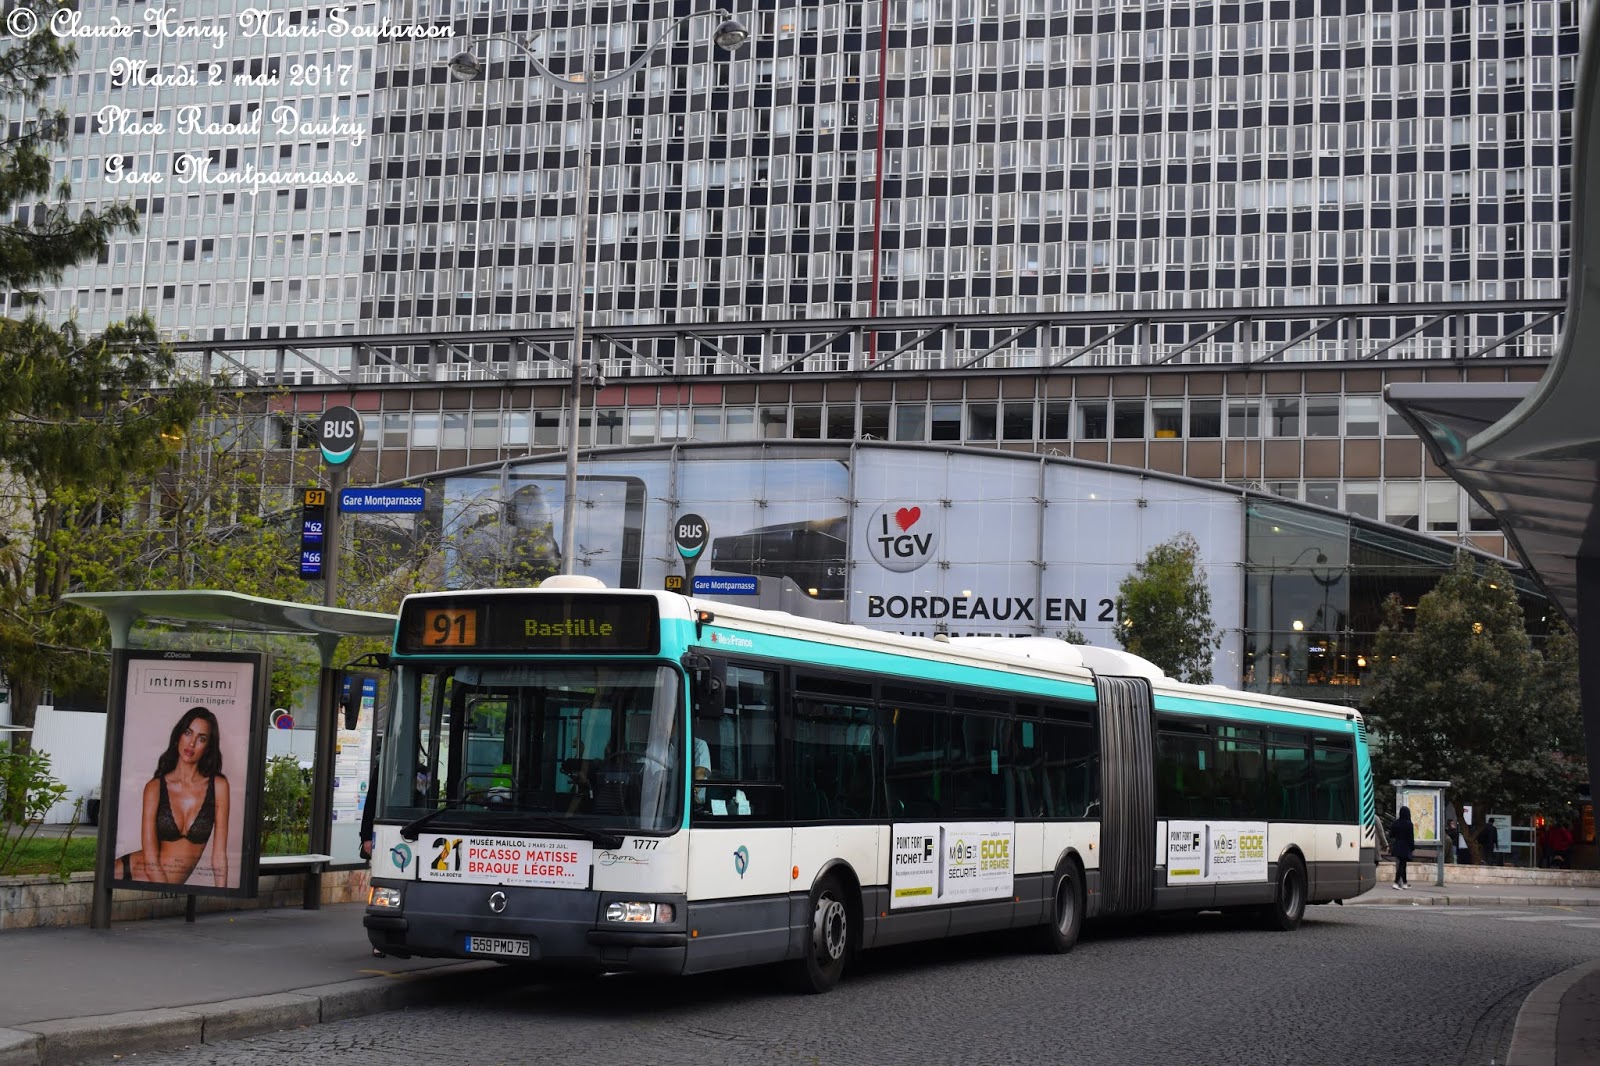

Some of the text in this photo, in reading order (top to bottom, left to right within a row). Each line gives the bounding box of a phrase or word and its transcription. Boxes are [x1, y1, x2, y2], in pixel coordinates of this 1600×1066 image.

[323, 420, 355, 439] BUS
[309, 491, 323, 504] 91
[343, 495, 422, 508] Gare Montparnasse
[679, 524, 703, 538] BUS
[882, 513, 888, 535] I
[878, 533, 933, 559] TGV
[668, 578, 680, 588] 91
[694, 581, 755, 591] Gare Montparnasse
[868, 595, 1034, 620] BORDEAUX
[1045, 598, 1087, 621] EN
[433, 613, 466, 644] 91
[525, 618, 613, 637] Bastille
[163, 651, 191, 659] JCDecaux
[149, 676, 232, 690] intimissimi
[180, 696, 236, 706] Italian lingerie
[896, 836, 922, 849] POINT FORT
[1170, 831, 1192, 840] POINT FORT
[470, 838, 494, 846] MUSÉE
[495, 840, 526, 848] MAILLOL
[633, 839, 659, 850] 1777
[981, 839, 1010, 859] 600€
[430, 837, 463, 872] 21
[469, 848, 578, 863] PICASSO MATISSE
[468, 861, 575, 877] BRAQUE LÉGER...
[948, 865, 977, 878] SÉCURITÉ
[980, 859, 1009, 870] DE REMISE
[473, 938, 492, 952] 559
[515, 941, 529, 955] 75
